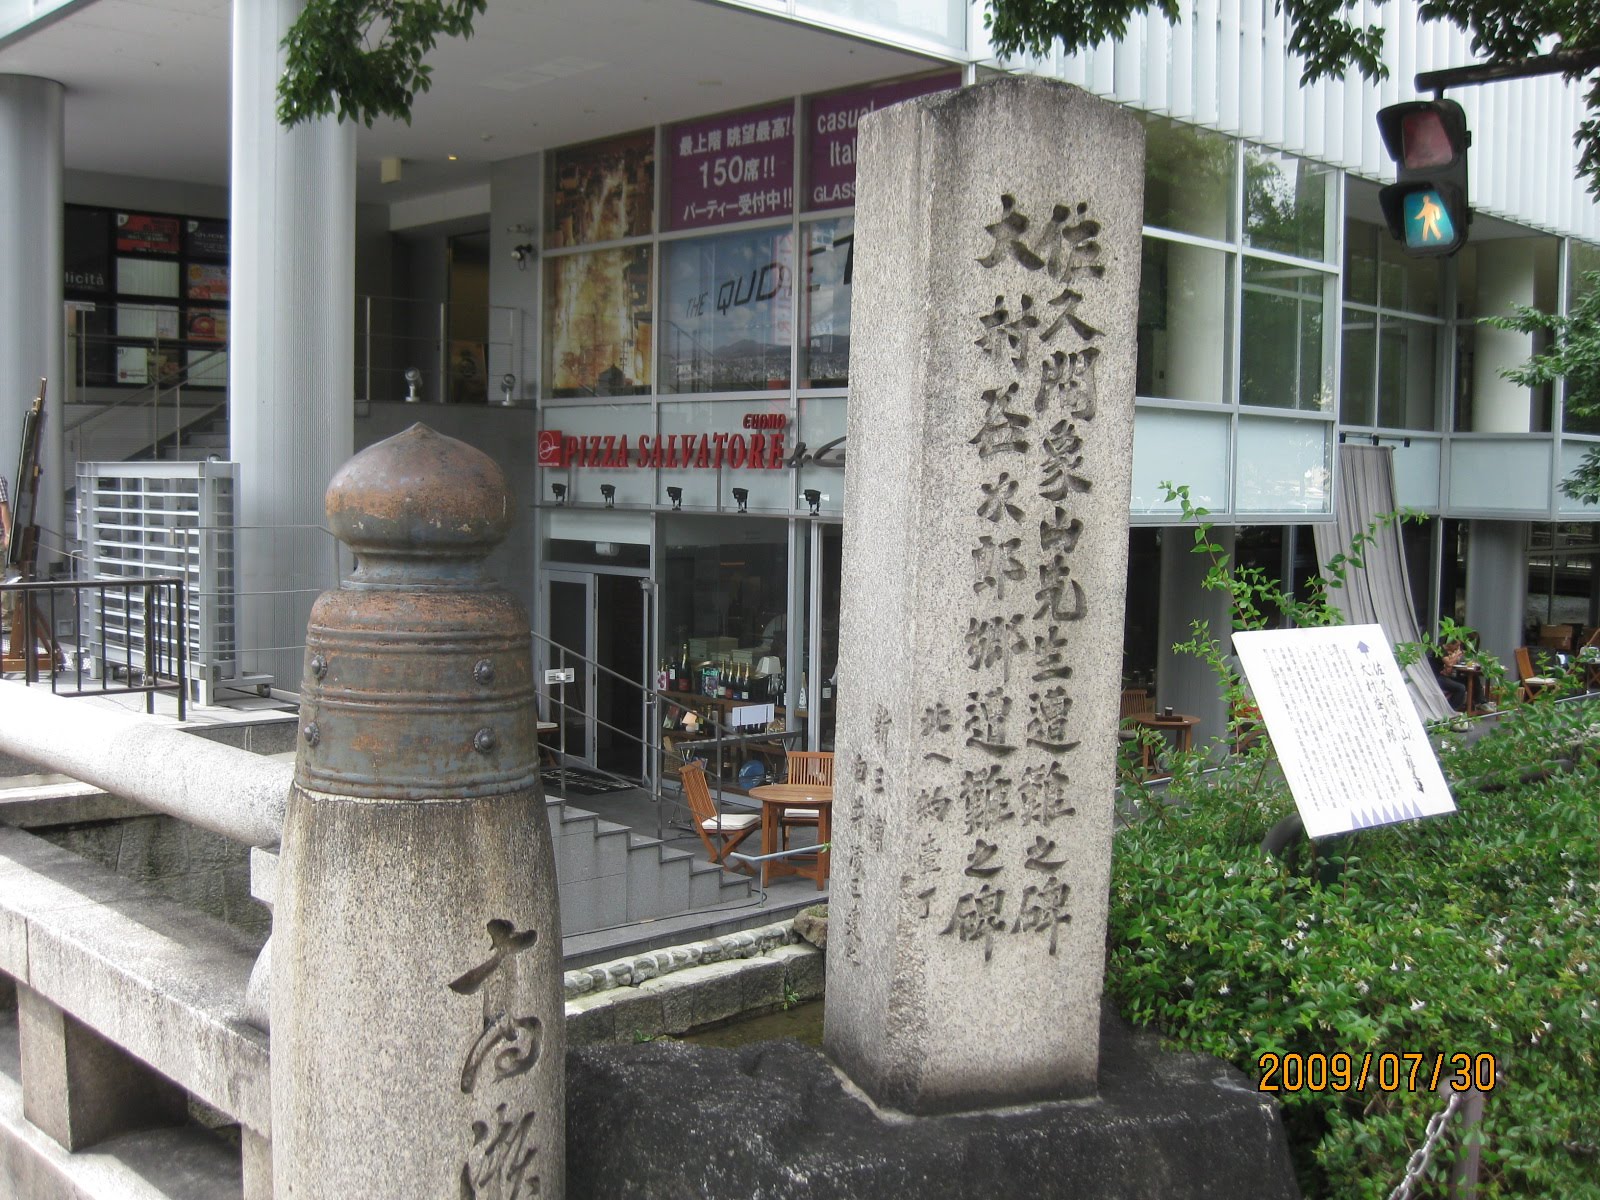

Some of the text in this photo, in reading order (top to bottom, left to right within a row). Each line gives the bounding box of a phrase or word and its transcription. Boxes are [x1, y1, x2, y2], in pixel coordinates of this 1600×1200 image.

[680, 129, 722, 156] 最上階
[686, 291, 709, 318] THE
[564, 433, 629, 469] PIZZA
[636, 430, 786, 470] SALVATORE
